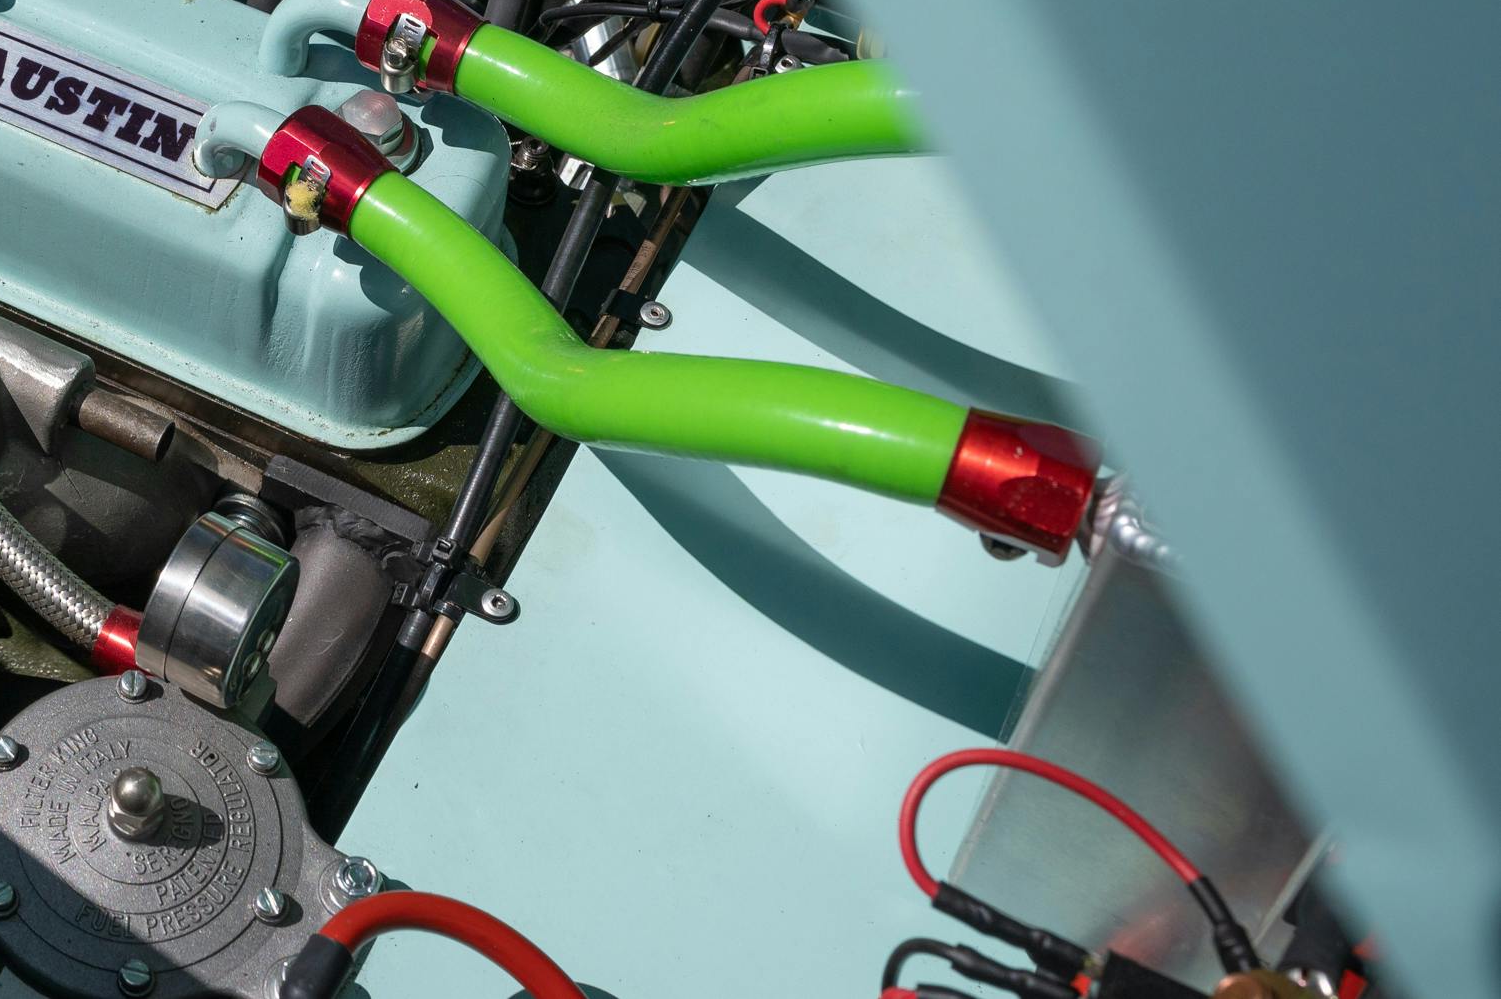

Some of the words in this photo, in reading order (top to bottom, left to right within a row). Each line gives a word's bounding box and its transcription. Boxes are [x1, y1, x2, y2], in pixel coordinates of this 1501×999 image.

[19, 764, 59, 829] FILTER
[50, 727, 100, 765] KING
[56, 770, 82, 795] IN
[75, 739, 131, 775] ITALY
[48, 800, 78, 865] MADE
[79, 766, 125, 853] MALPA
[189, 741, 252, 853] REGULATOR
[155, 813, 225, 906] PATENTED
[75, 903, 134, 940] FUEL
[146, 860, 245, 938] PRESSURE
